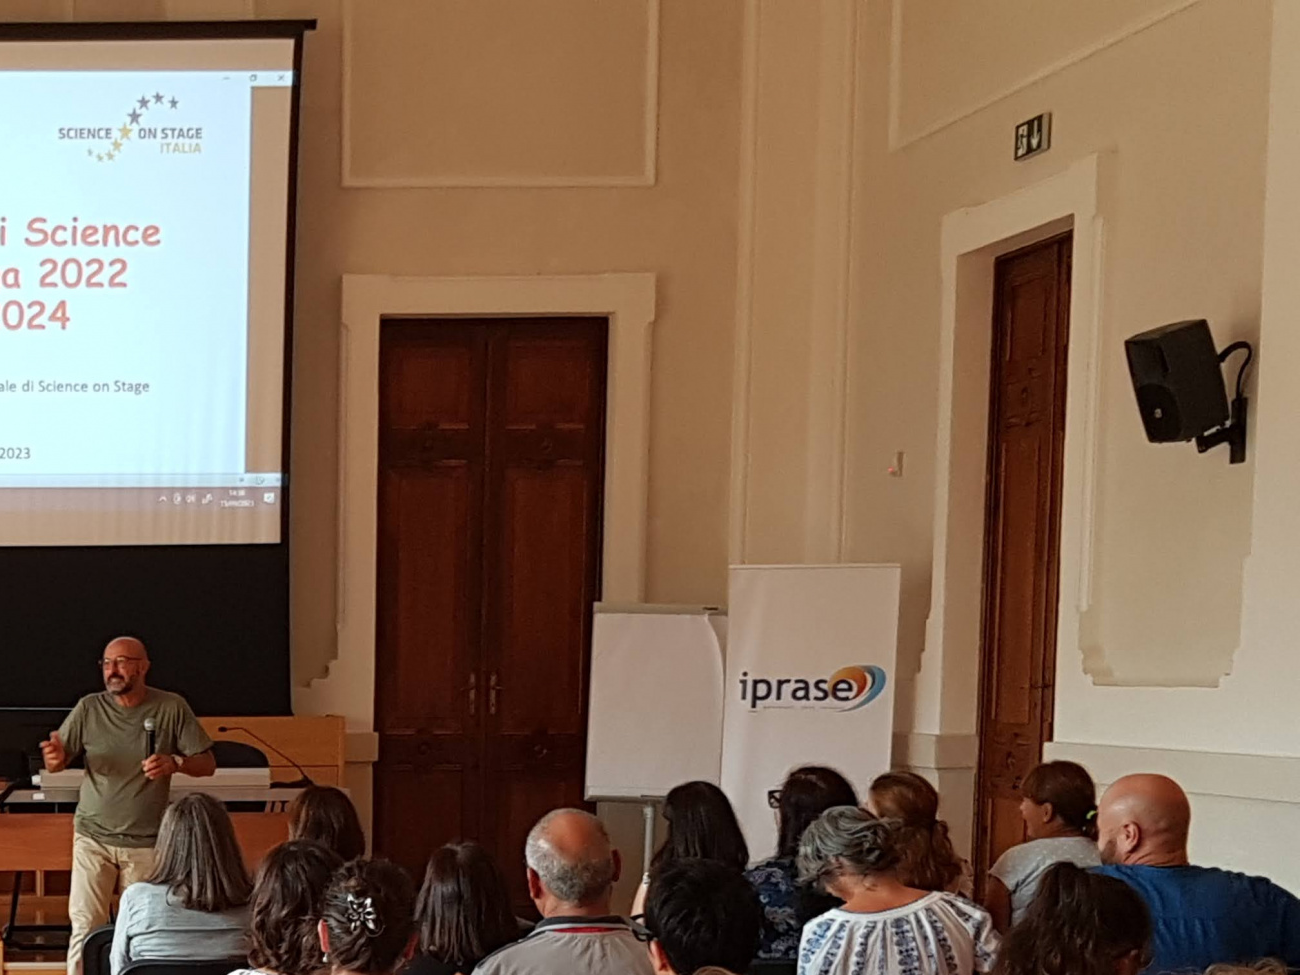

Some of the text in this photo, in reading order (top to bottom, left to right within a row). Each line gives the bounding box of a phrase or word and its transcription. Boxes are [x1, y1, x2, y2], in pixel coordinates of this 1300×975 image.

[58, 127, 203, 140] SCIENCE ON STAGE
[160, 142, 202, 155] ITALIA
[24, 216, 161, 248] Science
[38, 257, 128, 289] 2022
[21, 379, 35, 393] di
[38, 379, 89, 393] Science
[92, 382, 110, 393] on
[113, 379, 150, 396] Stage
[739, 671, 854, 709] iprase
